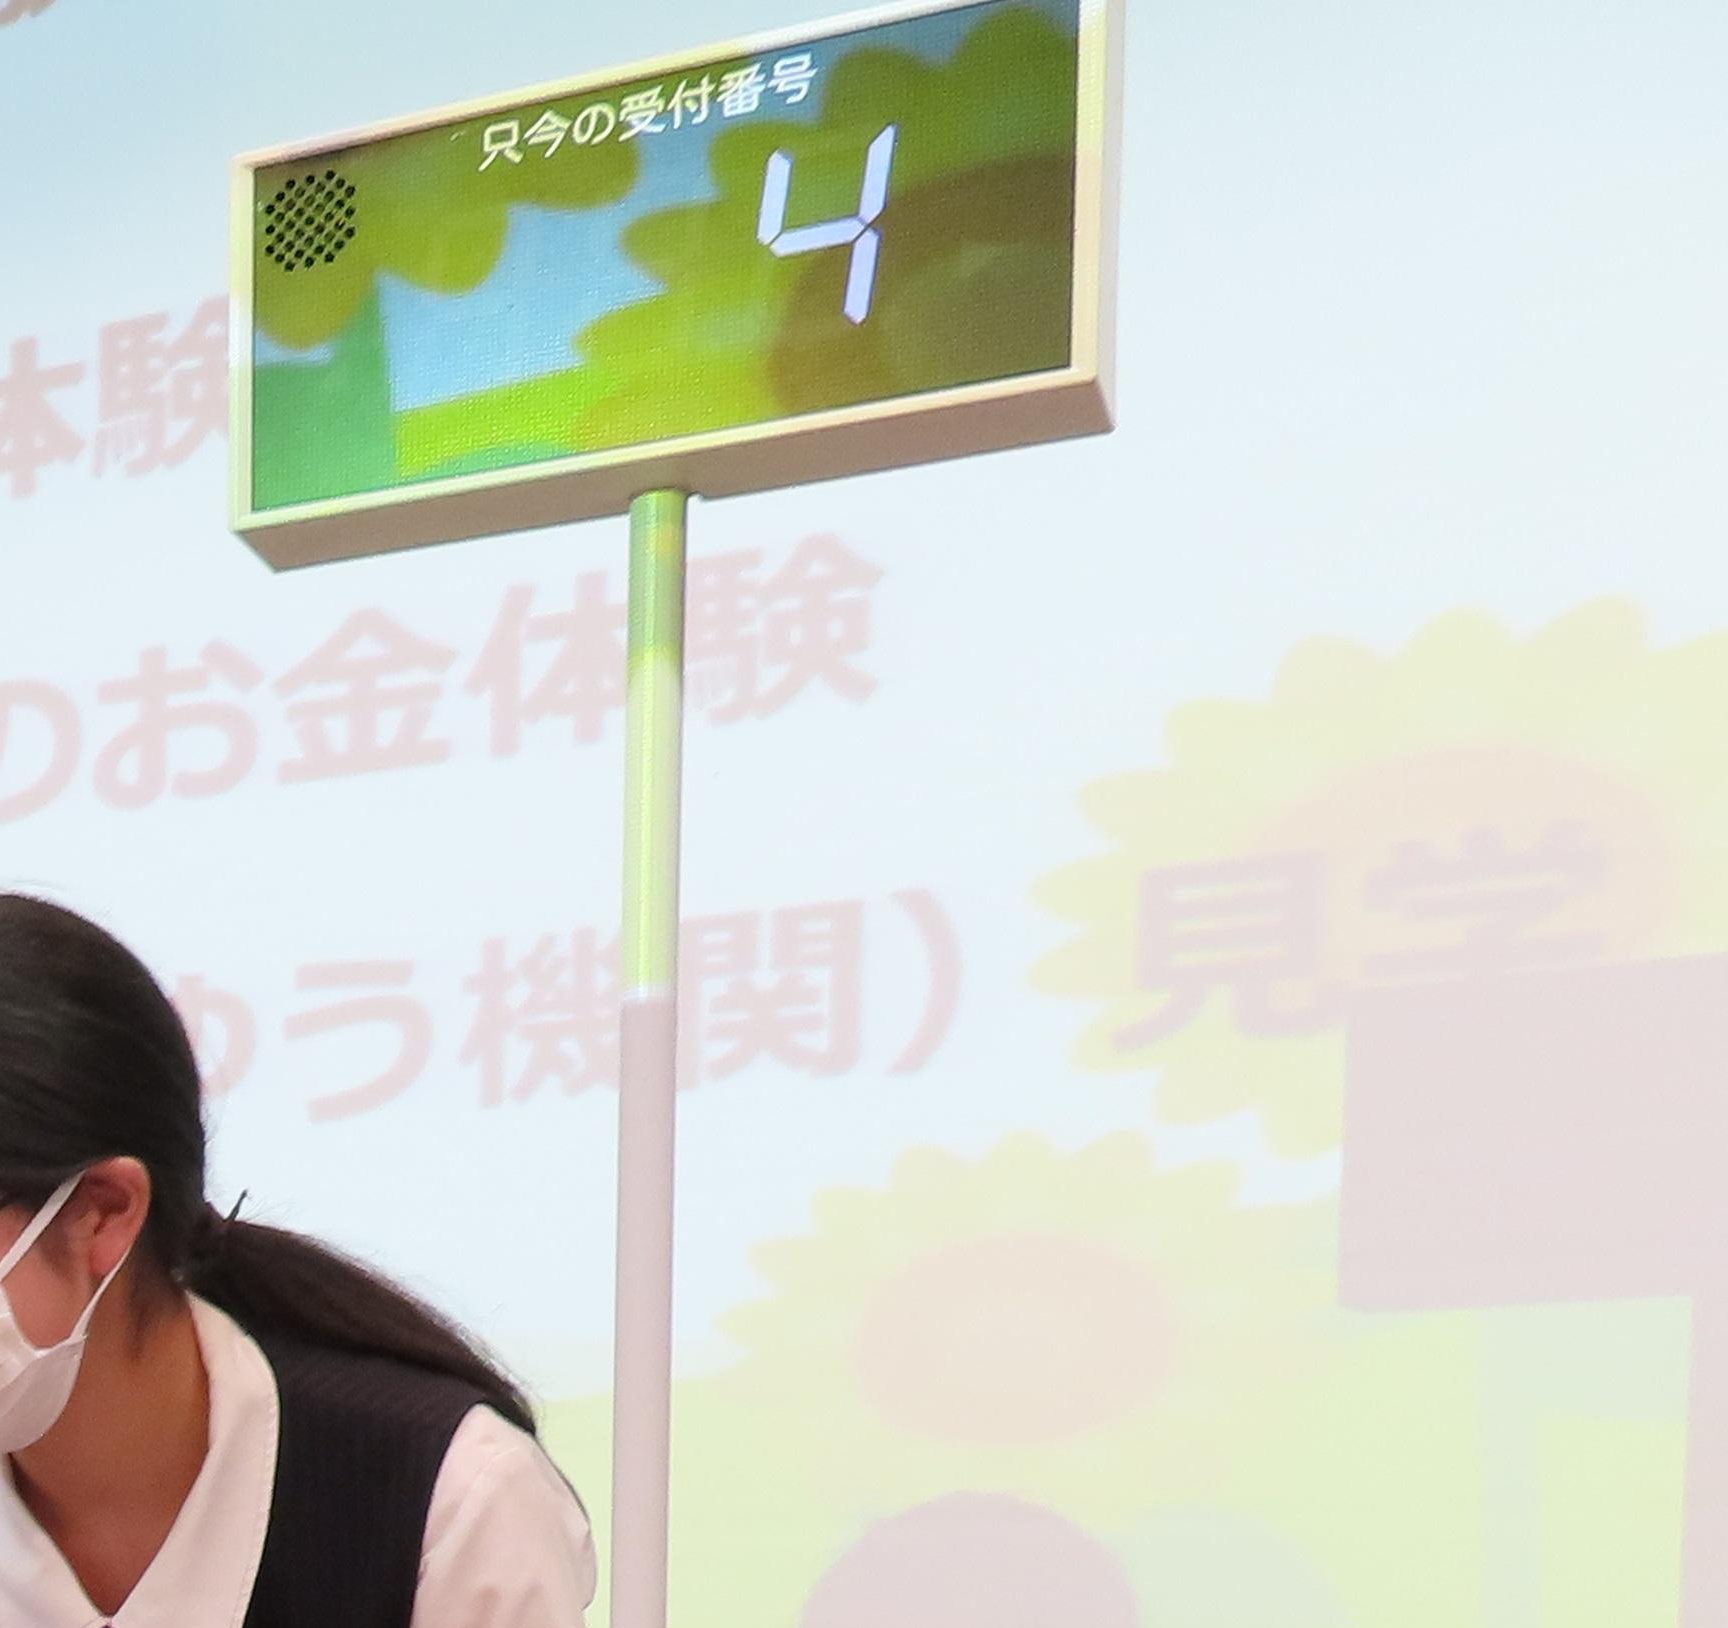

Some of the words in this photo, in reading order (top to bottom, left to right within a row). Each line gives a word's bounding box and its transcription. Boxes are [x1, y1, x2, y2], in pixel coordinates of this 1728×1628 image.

[478, 51, 818, 171] 只今の受付番号
[756, 122, 898, 325] 4
